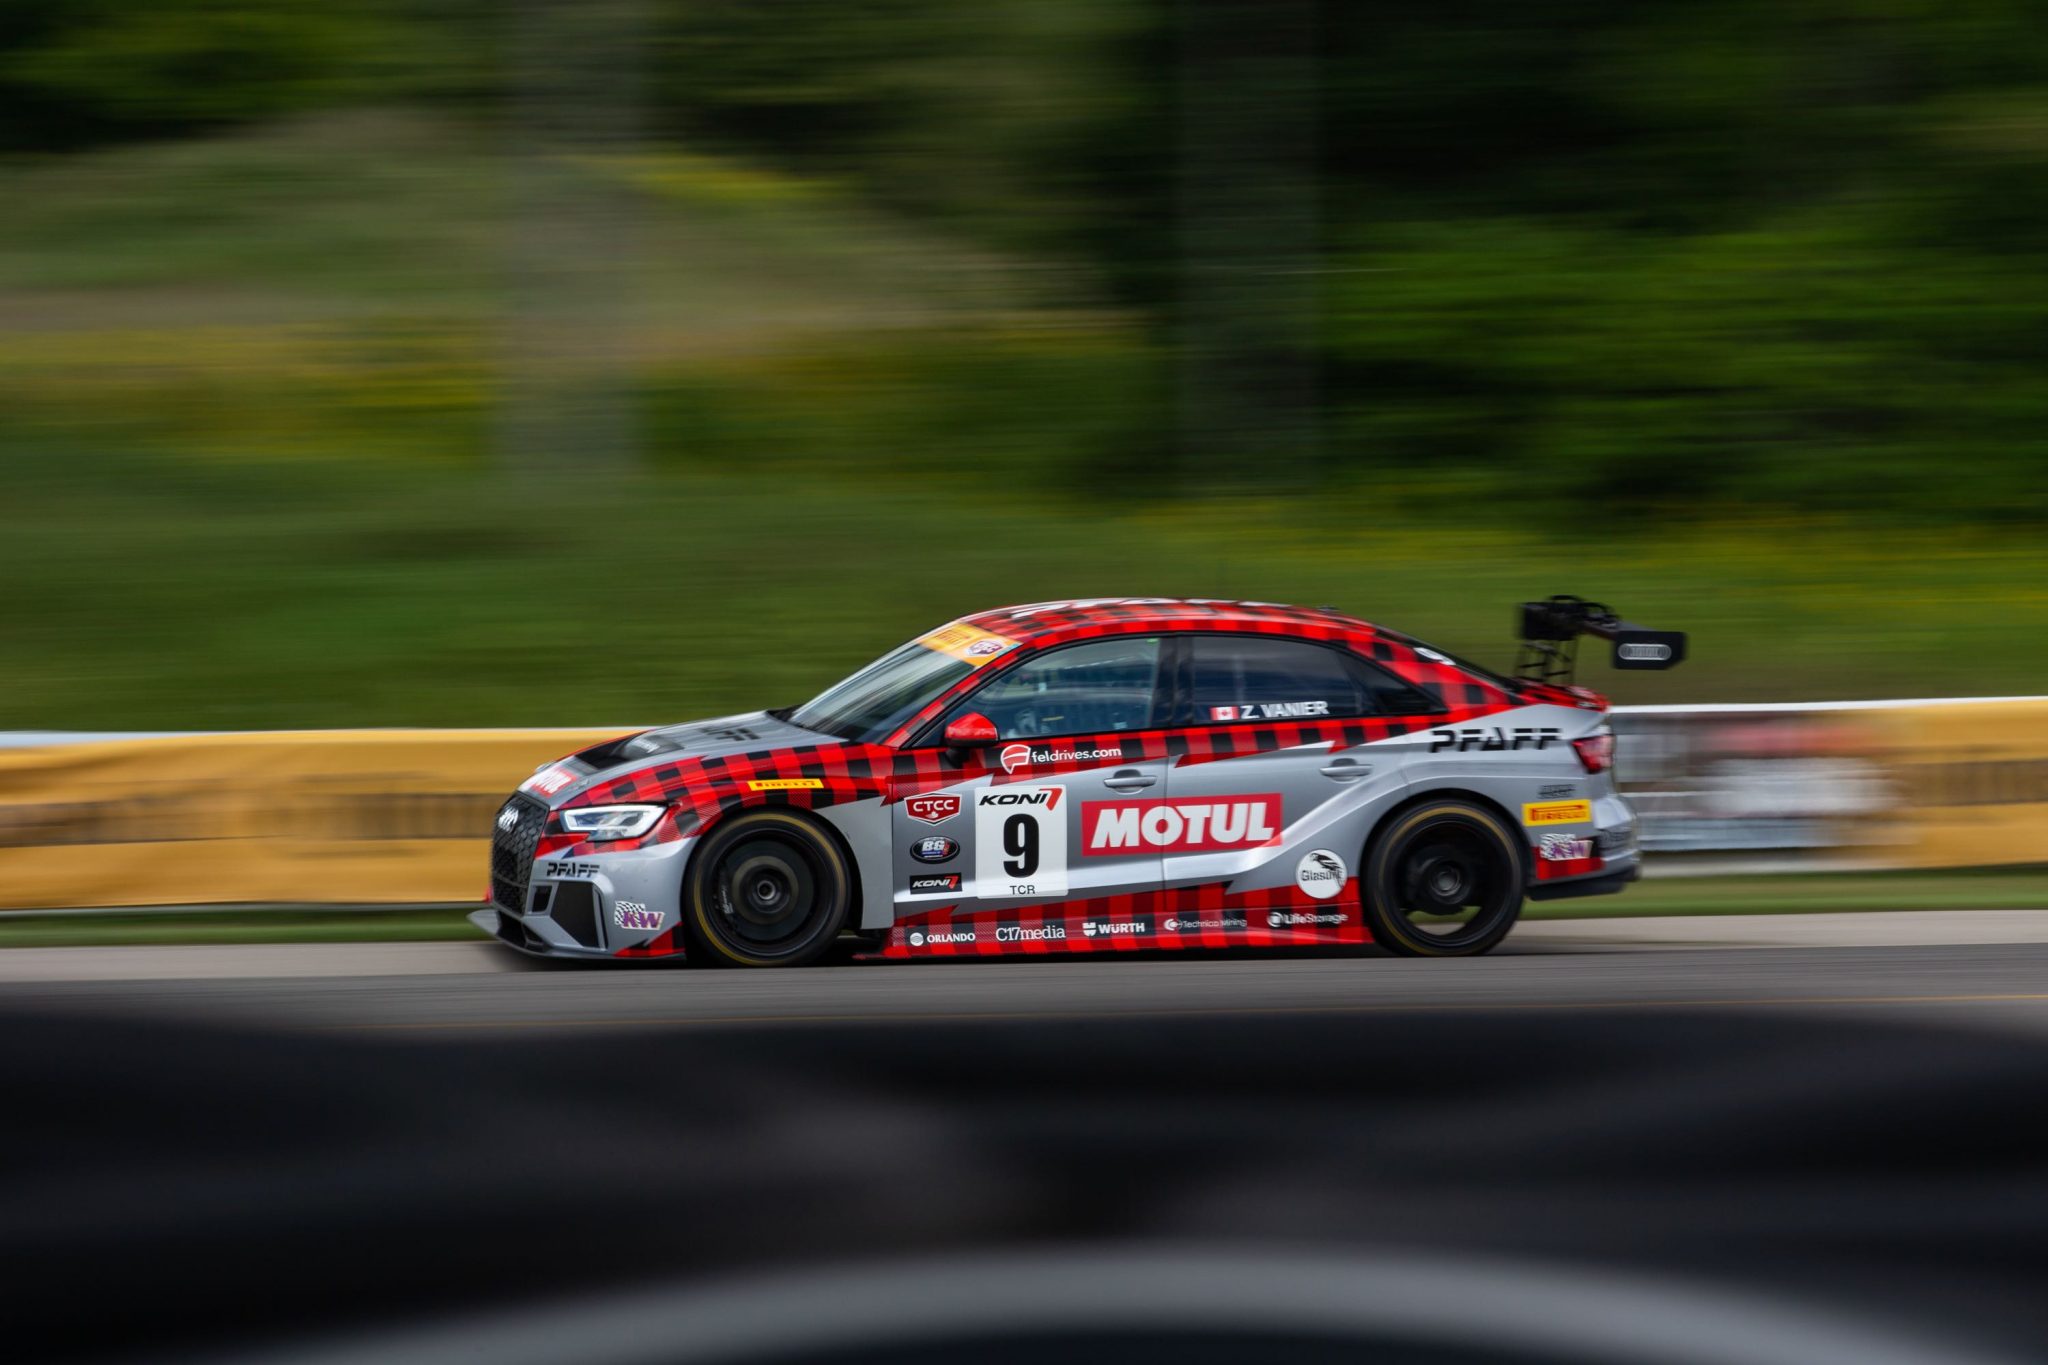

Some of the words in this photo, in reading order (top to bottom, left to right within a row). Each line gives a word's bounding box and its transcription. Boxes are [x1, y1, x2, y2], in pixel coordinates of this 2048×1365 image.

[1260, 700, 1330, 718] VANIER
[1430, 727, 1562, 753] PFAFF
[1031, 747, 1122, 763] feldrives.com
[912, 799, 954, 812] CTCC
[1090, 802, 1275, 848] MOTUL
[1003, 813, 1039, 878] 9
[547, 862, 600, 877] PFAFF
[1010, 885, 1036, 895] TCR
[623, 911, 662, 929] KW
[926, 932, 976, 943] ORLANDO
[995, 926, 1066, 942] C17media
